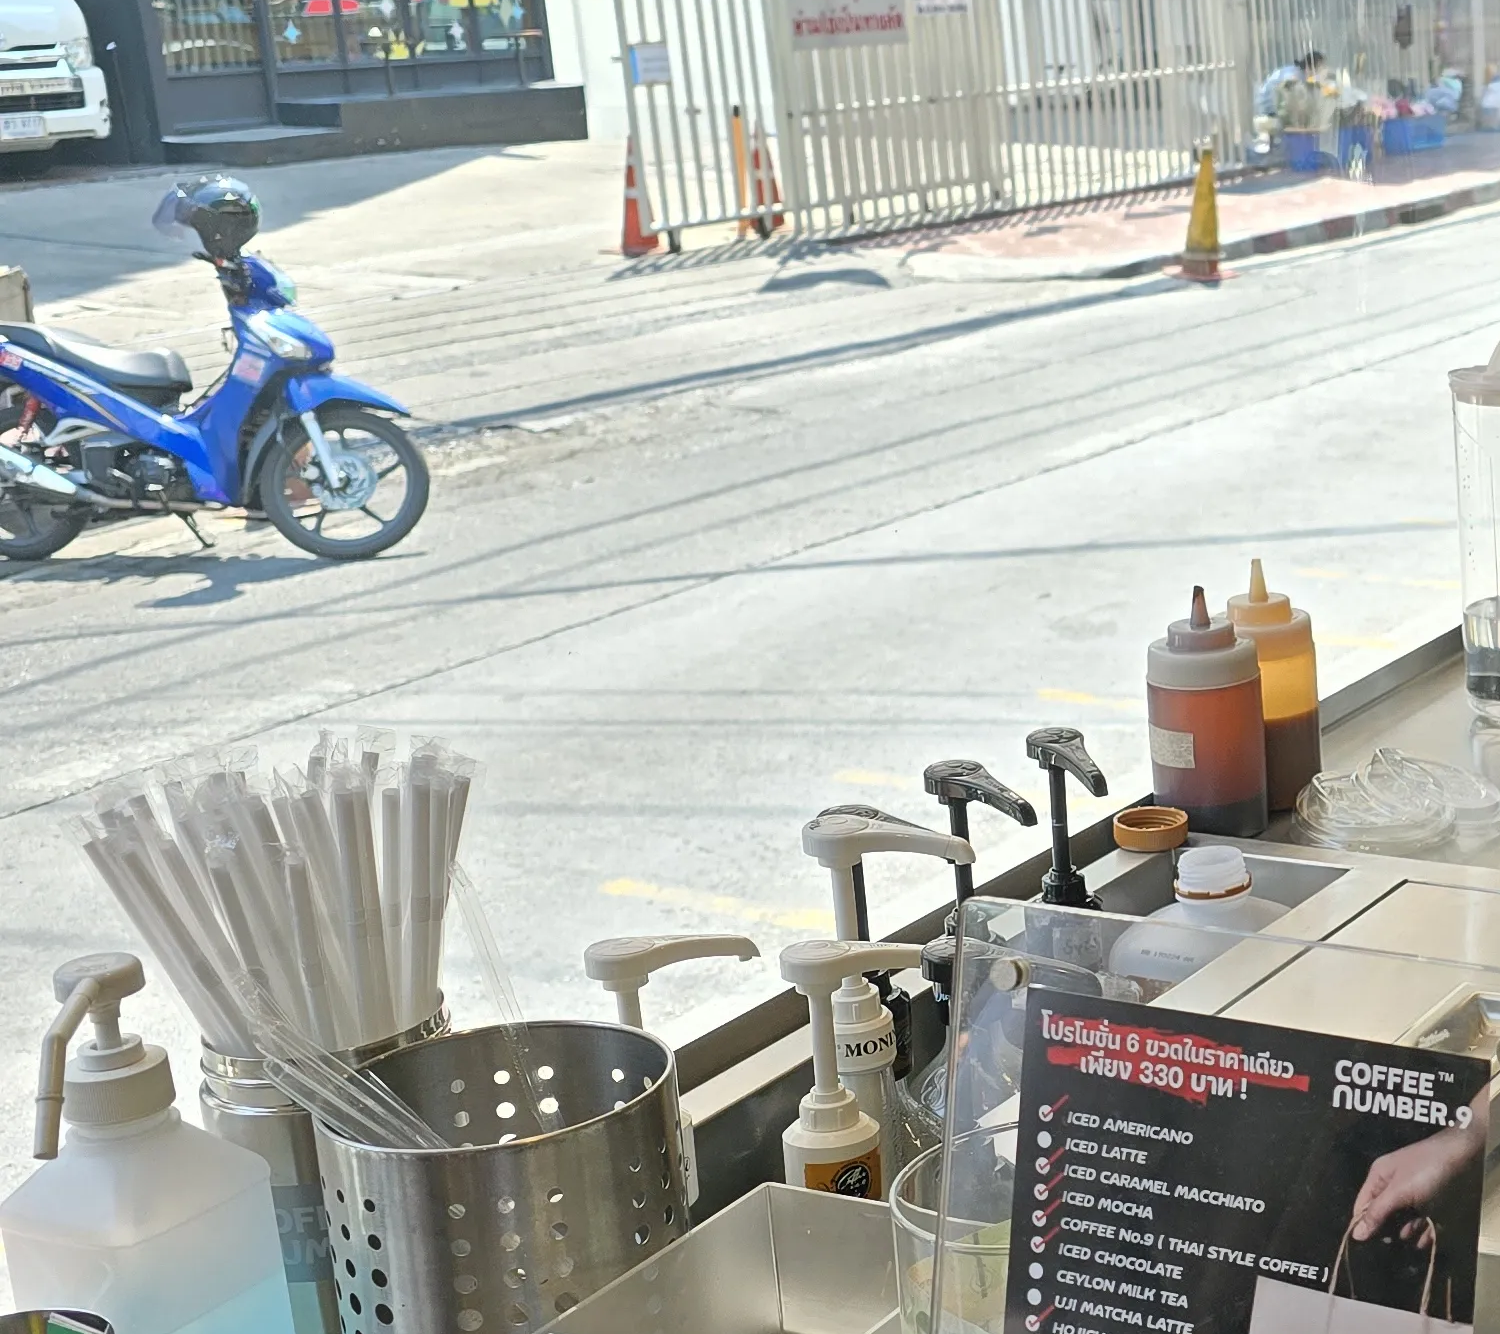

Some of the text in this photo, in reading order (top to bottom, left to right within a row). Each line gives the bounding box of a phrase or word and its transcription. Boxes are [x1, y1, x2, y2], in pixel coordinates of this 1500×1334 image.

[845, 1029, 896, 1058] MONI
[1040, 1009, 1295, 1079] โปรโมชั่น 6 ขวดในราคาเดียว
[1080, 1051, 1133, 1081] เพียง
[1139, 1061, 1183, 1089] 330
[1190, 1072, 1233, 1098] บาท
[1334, 1059, 1435, 1097] COFFEE
[1066, 1110, 1194, 1145] ICED AMERICANO
[1065, 1137, 1148, 1165] ICED LATTE
[1061, 1190, 1154, 1220] ICED MOCHA
[1063, 1164, 1266, 1214] ICED CARAMEL MACCHIATO
[1058, 1243, 1184, 1280] ICED CHOCOLATE
[1060, 1217, 1319, 1280] COFFEE No.9 THAI STYLE COFFEE
[1056, 1269, 1189, 1309] CEYLON MILK TEA
[1054, 1295, 1078, 1312] UJI
[1080, 1301, 1143, 1326] MATCHA
